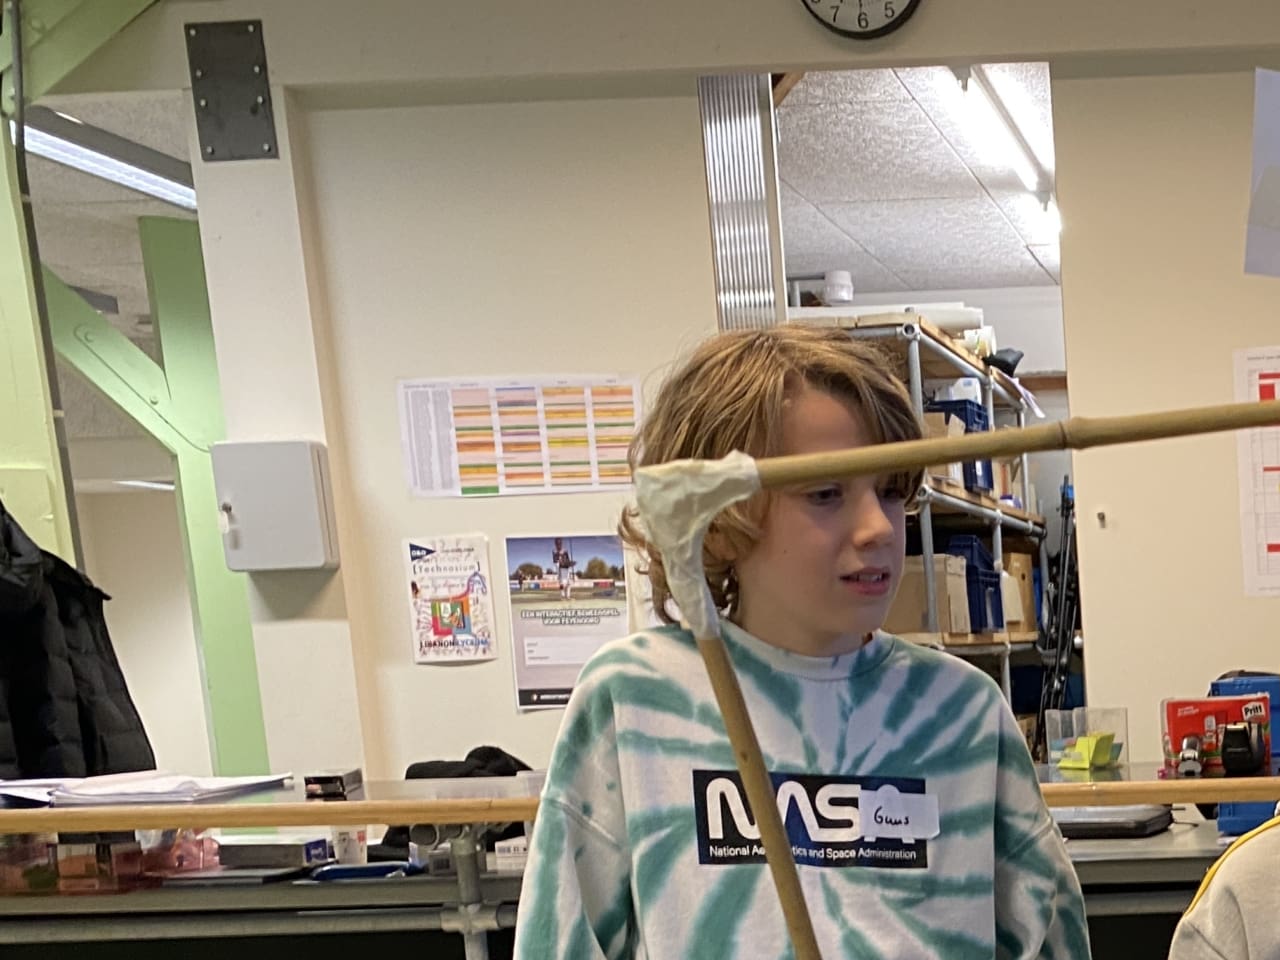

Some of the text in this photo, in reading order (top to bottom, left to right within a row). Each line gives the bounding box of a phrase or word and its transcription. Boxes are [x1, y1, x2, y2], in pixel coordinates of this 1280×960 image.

[830, 6, 840, 23] 7
[884, 2, 895, 18] 5
[857, 12, 869, 29] 6
[1244, 705, 1263, 716] Pritt
[709, 846, 750, 857] National
[808, 848, 825, 859] and
[826, 848, 856, 861] Space
[858, 847, 917, 860] Administration
